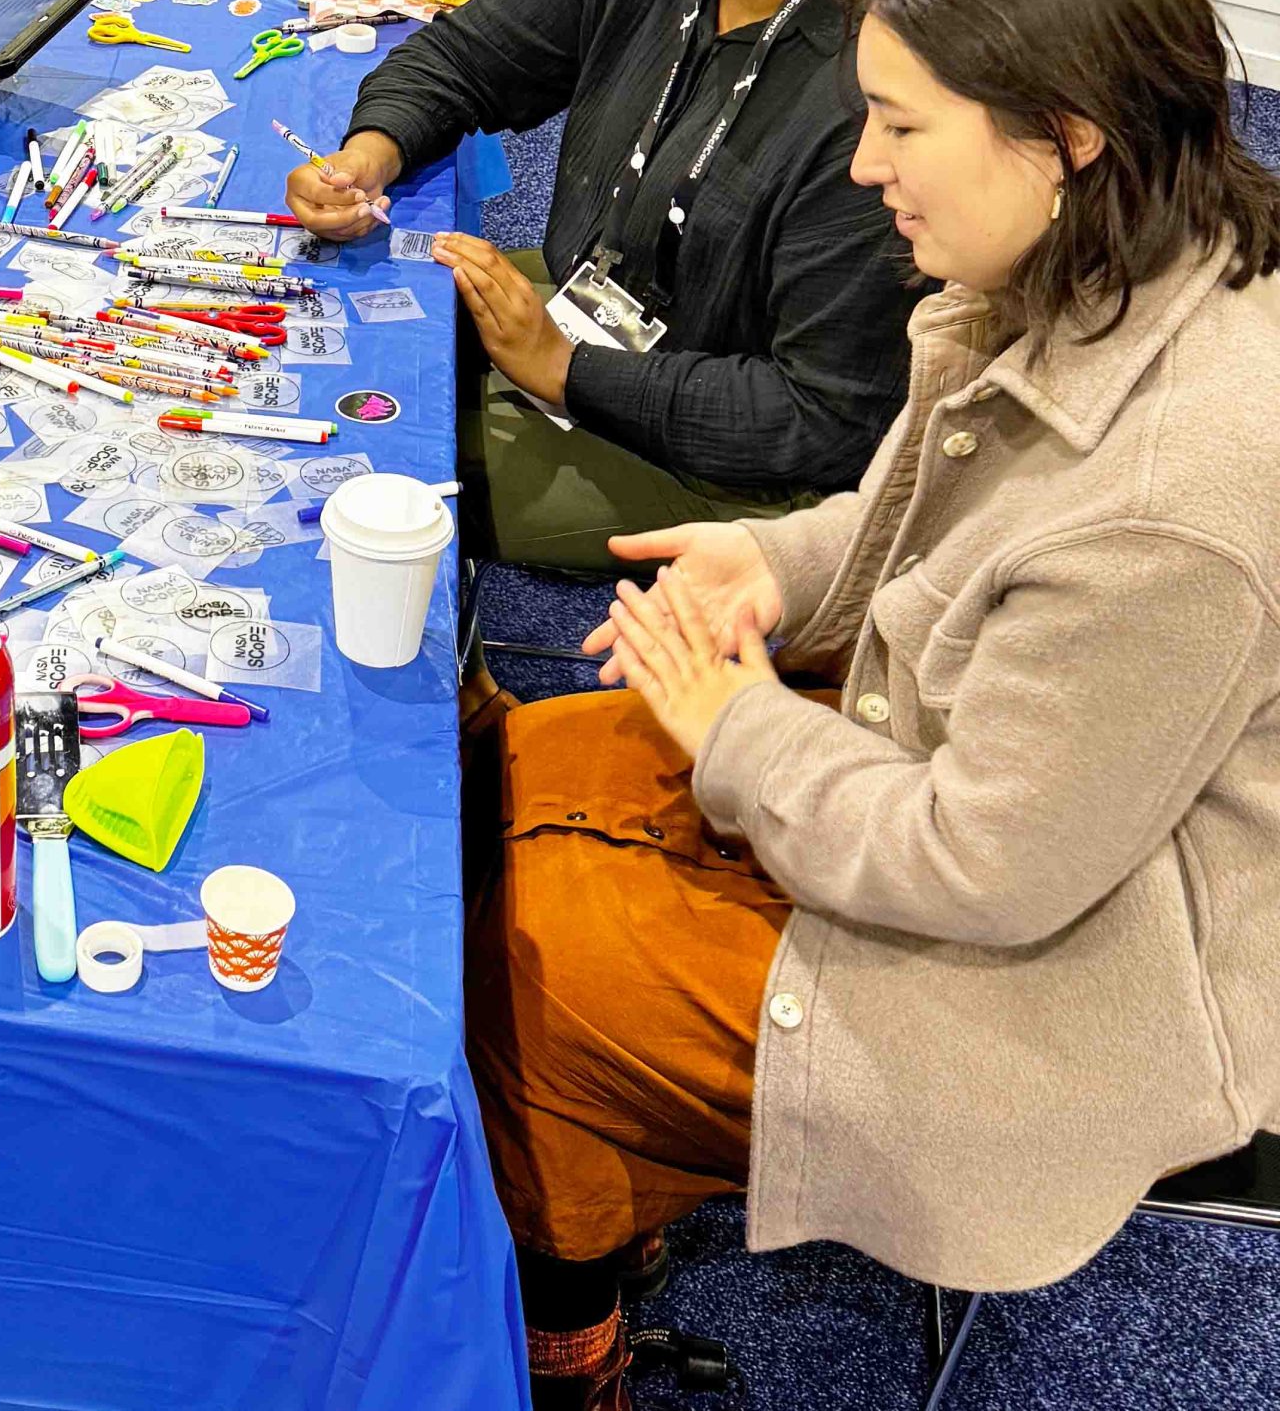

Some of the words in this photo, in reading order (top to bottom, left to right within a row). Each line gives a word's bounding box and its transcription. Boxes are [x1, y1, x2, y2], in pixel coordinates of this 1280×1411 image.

[689, 117, 727, 180] AbSciCon24
[160, 238, 198, 252] CoPE
[301, 332, 311, 349] NASA
[312, 327, 326, 354] SCoPE
[253, 379, 263, 399] NASA
[264, 376, 280, 406] SCoPE
[315, 466, 351, 475] NASA
[235, 633, 248, 658] NASA
[248, 626, 267, 668] SCoPE
[36, 656, 48, 681] NASA
